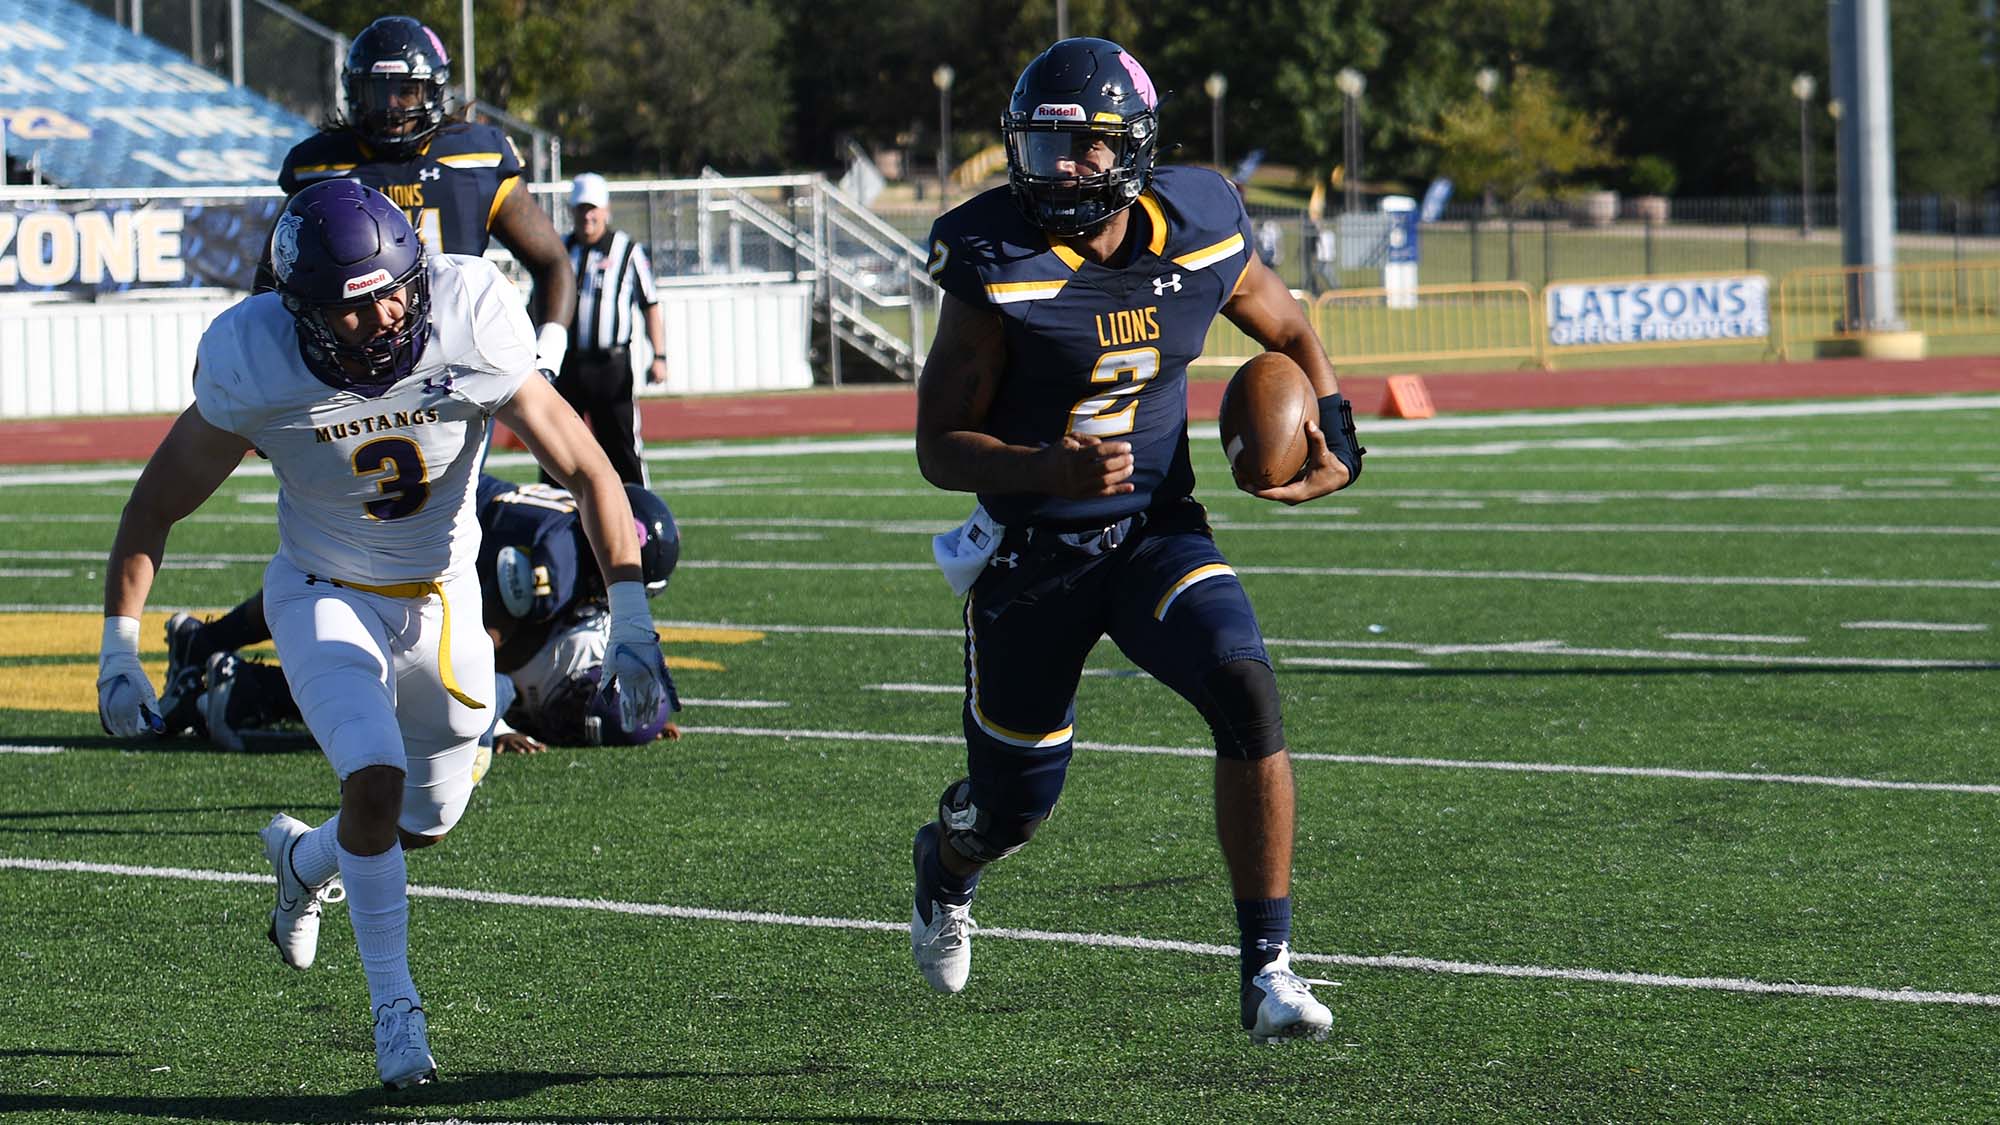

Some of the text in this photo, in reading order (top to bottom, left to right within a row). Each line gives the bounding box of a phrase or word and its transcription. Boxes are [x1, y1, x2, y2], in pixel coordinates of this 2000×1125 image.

[1038, 107, 1077, 117] Riddell
[379, 183, 424, 207] IONS
[346, 274, 386, 292] Riddell
[1553, 282, 1747, 322] LATSONS
[1095, 306, 1160, 347] LIONS
[1551, 318, 1769, 345] OFFICE PRODUCTS
[1065, 346, 1161, 439] 2
[315, 408, 440, 443] MUSTANGS
[351, 435, 431, 522] 3
